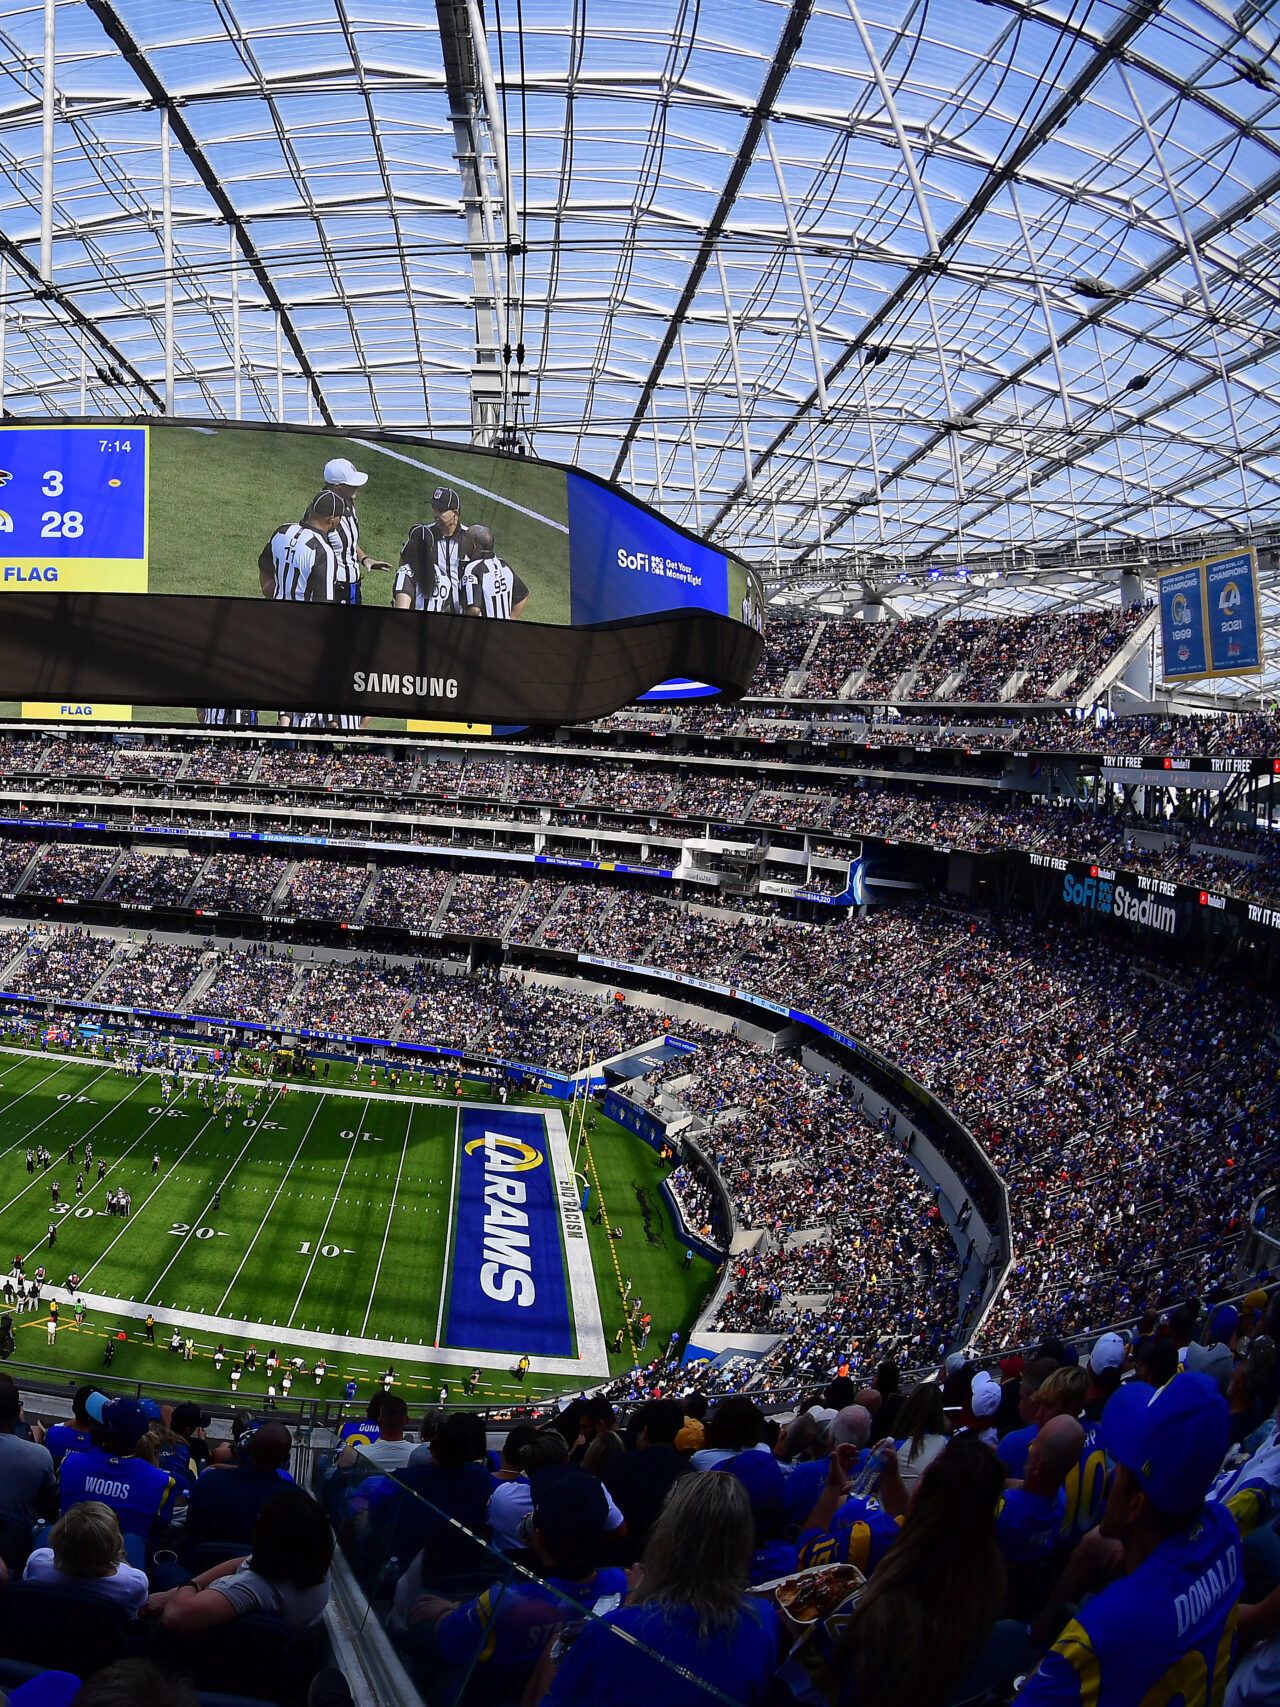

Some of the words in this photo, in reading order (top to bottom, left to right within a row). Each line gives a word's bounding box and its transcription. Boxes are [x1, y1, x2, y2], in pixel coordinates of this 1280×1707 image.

[98, 440, 131, 453] 7:14
[41, 470, 64, 497] 3
[40, 510, 84, 538] 28
[617, 548, 649, 573] SoFi
[666, 559, 677, 569] Get
[678, 562, 692, 573] Your
[4, 567, 58, 581] FLAG
[666, 569, 687, 583] Money
[688, 574, 702, 586] Right
[1209, 565, 1248, 582] CHAMPIONS
[494, 577, 508, 595] 95
[1162, 578, 1198, 593] CHAMPIONS
[1172, 629, 1192, 640] 1999
[1221, 620, 1242, 632] 2021
[353, 671, 458, 699] SAMSUNG
[60, 706, 92, 716] FLAG
[1103, 756, 1116, 766] TRY
[1117, 756, 1124, 767] IT
[1211, 759, 1224, 771] TRY
[1224, 759, 1232, 772] IT
[1030, 854, 1042, 865] TRY
[1043, 855, 1050, 867] IT
[1138, 875, 1150, 888] TRY
[1151, 877, 1159, 891] IT
[1063, 873, 1096, 909] SoFi
[1114, 885, 1176, 934] Stadium
[1248, 904, 1262, 922] TRY
[1263, 908, 1271, 924] IT
[309, 1032, 353, 1042] HOUSE
[560, 1181, 576, 1201] END
[48, 1202, 95, 1219] 30
[563, 1201, 584, 1239] RACISM
[167, 1222, 218, 1240] 20
[479, 1173, 535, 1307] RAMS
[296, 1241, 340, 1259] 10
[85, 1476, 130, 1500] WOODS
[1173, 1545, 1237, 1638] DONALD
